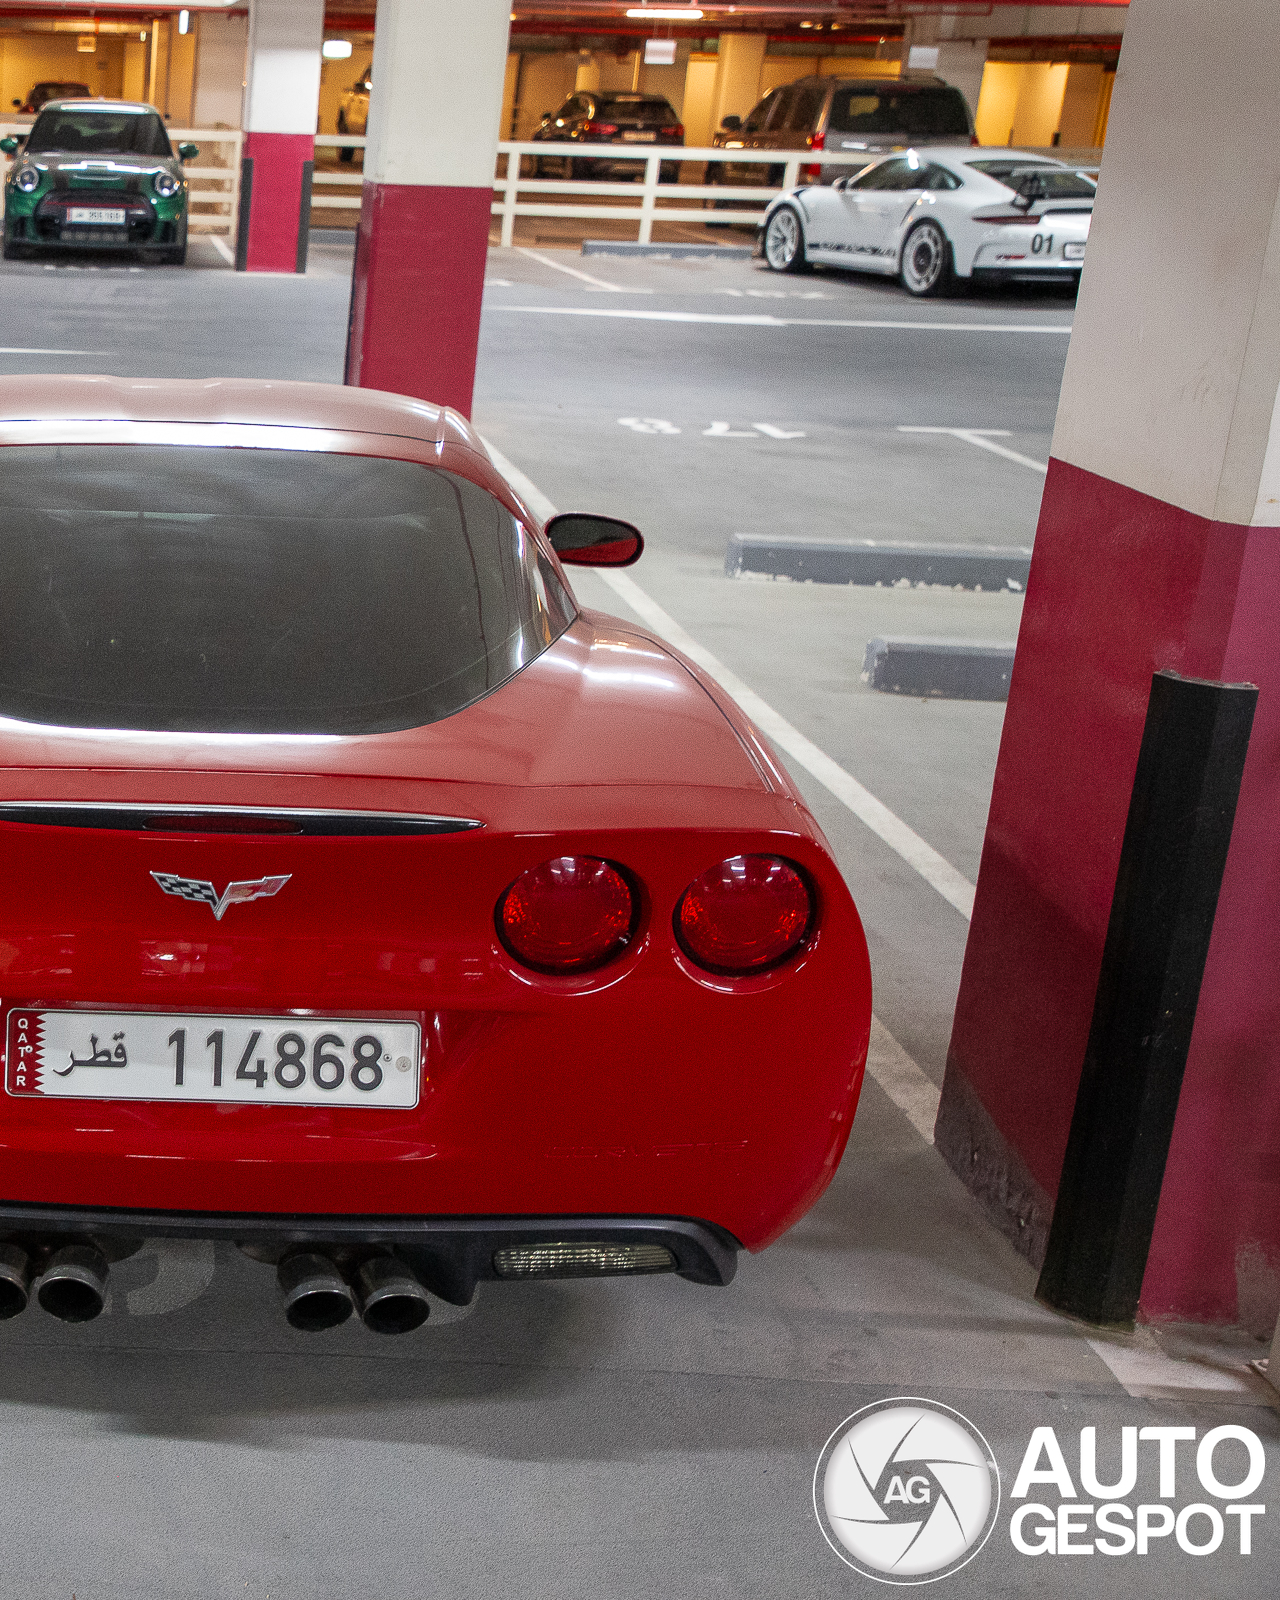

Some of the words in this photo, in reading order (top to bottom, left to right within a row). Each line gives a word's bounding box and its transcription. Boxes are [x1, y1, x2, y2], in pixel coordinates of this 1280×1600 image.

[1031, 233, 1054, 254] 01
[16, 1018, 29, 1087] QATAR
[52, 1031, 128, 1077] قطر
[168, 1029, 384, 1092] 114868
